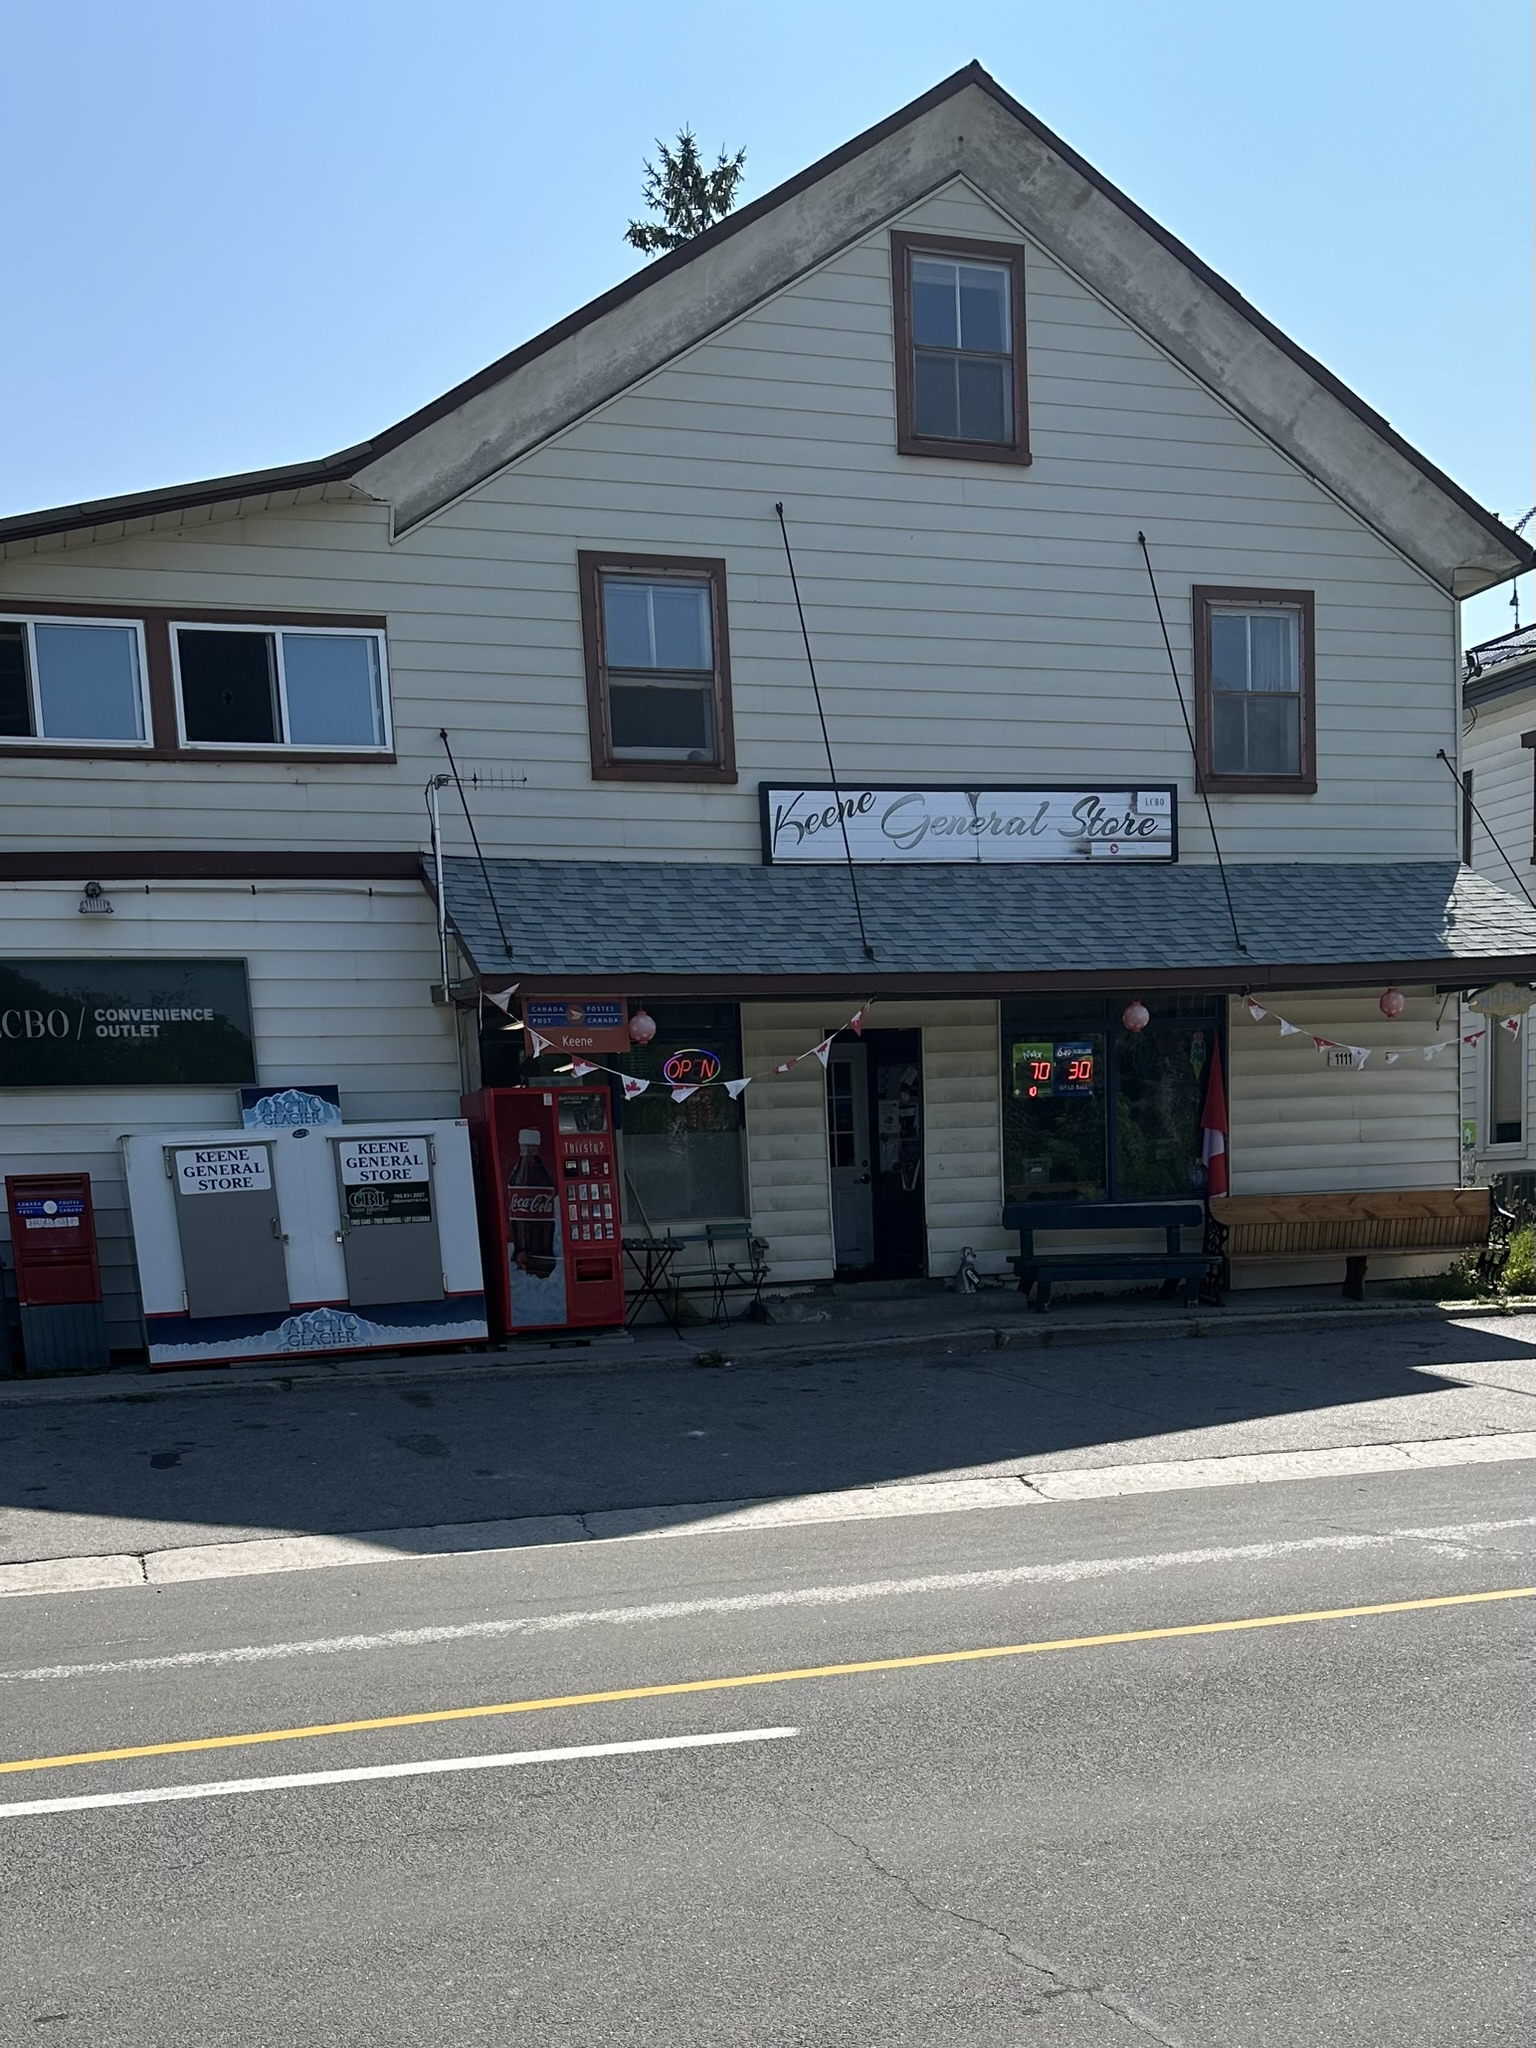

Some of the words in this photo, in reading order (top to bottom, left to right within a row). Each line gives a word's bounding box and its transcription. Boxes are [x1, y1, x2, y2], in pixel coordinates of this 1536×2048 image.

[1144, 797, 1166, 807] LCBO
[772, 792, 877, 855] Keene
[881, 792, 1050, 851] General
[1057, 795, 1159, 838] Store
[93, 1008, 215, 1022] CONVENIENCE
[531, 1005, 564, 1013] CANADA
[0, 1008, 70, 1040] CBO
[95, 1024, 161, 1038] OUTLET
[562, 1035, 594, 1047] Keene
[1335, 1052, 1353, 1065] 1111
[1030, 1061, 1051, 1081] 70
[1067, 1060, 1091, 1080] 30
[262, 1096, 321, 1114] ARCTIC
[262, 1111, 321, 1126] GLACIER
[357, 1141, 410, 1154] KEENE
[564, 1141, 604, 1156] Thirsty?
[195, 1149, 250, 1163] KEENE
[346, 1154, 424, 1169] GENERAL
[183, 1162, 265, 1178] GENERAL
[359, 1168, 412, 1182] STORE
[198, 1176, 254, 1191] STORE
[511, 1193, 553, 1213] Coca-Cola
[287, 1313, 358, 1336] ARCTIC
[287, 1330, 359, 1347] GLACIER
